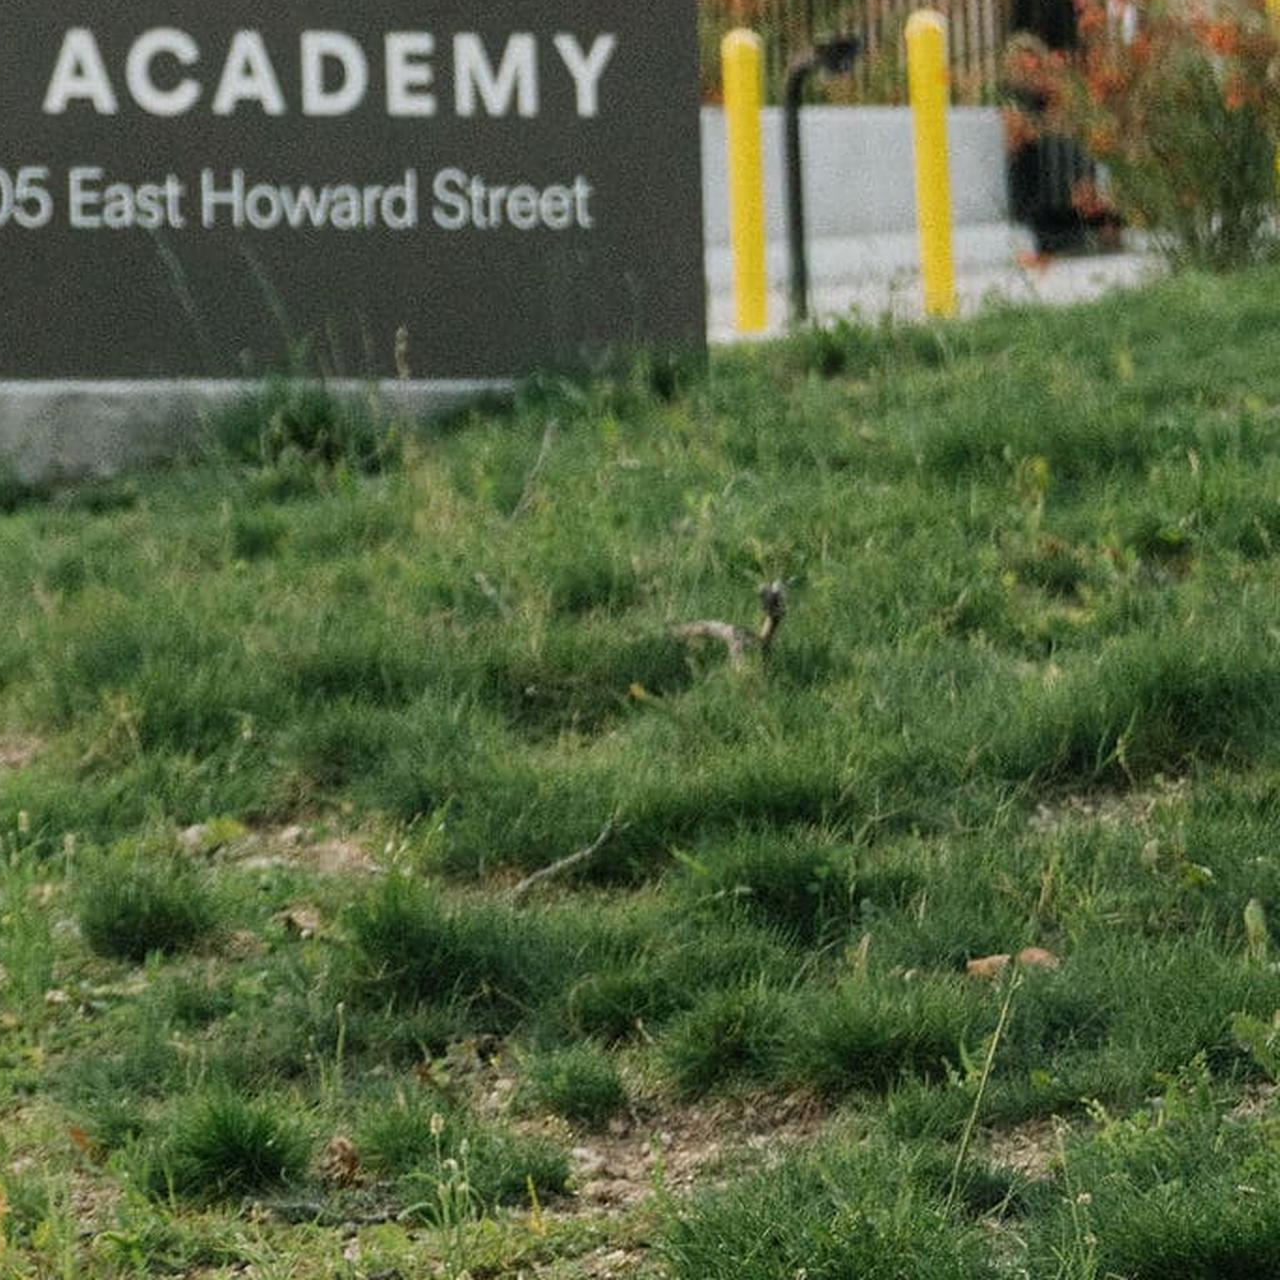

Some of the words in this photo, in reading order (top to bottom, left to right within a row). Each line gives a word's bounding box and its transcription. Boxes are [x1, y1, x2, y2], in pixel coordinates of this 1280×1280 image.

[42, 27, 616, 118] ACADEMY
[68, 167, 183, 228] East
[200, 168, 417, 229] Howard
[432, 168, 593, 229] Street
